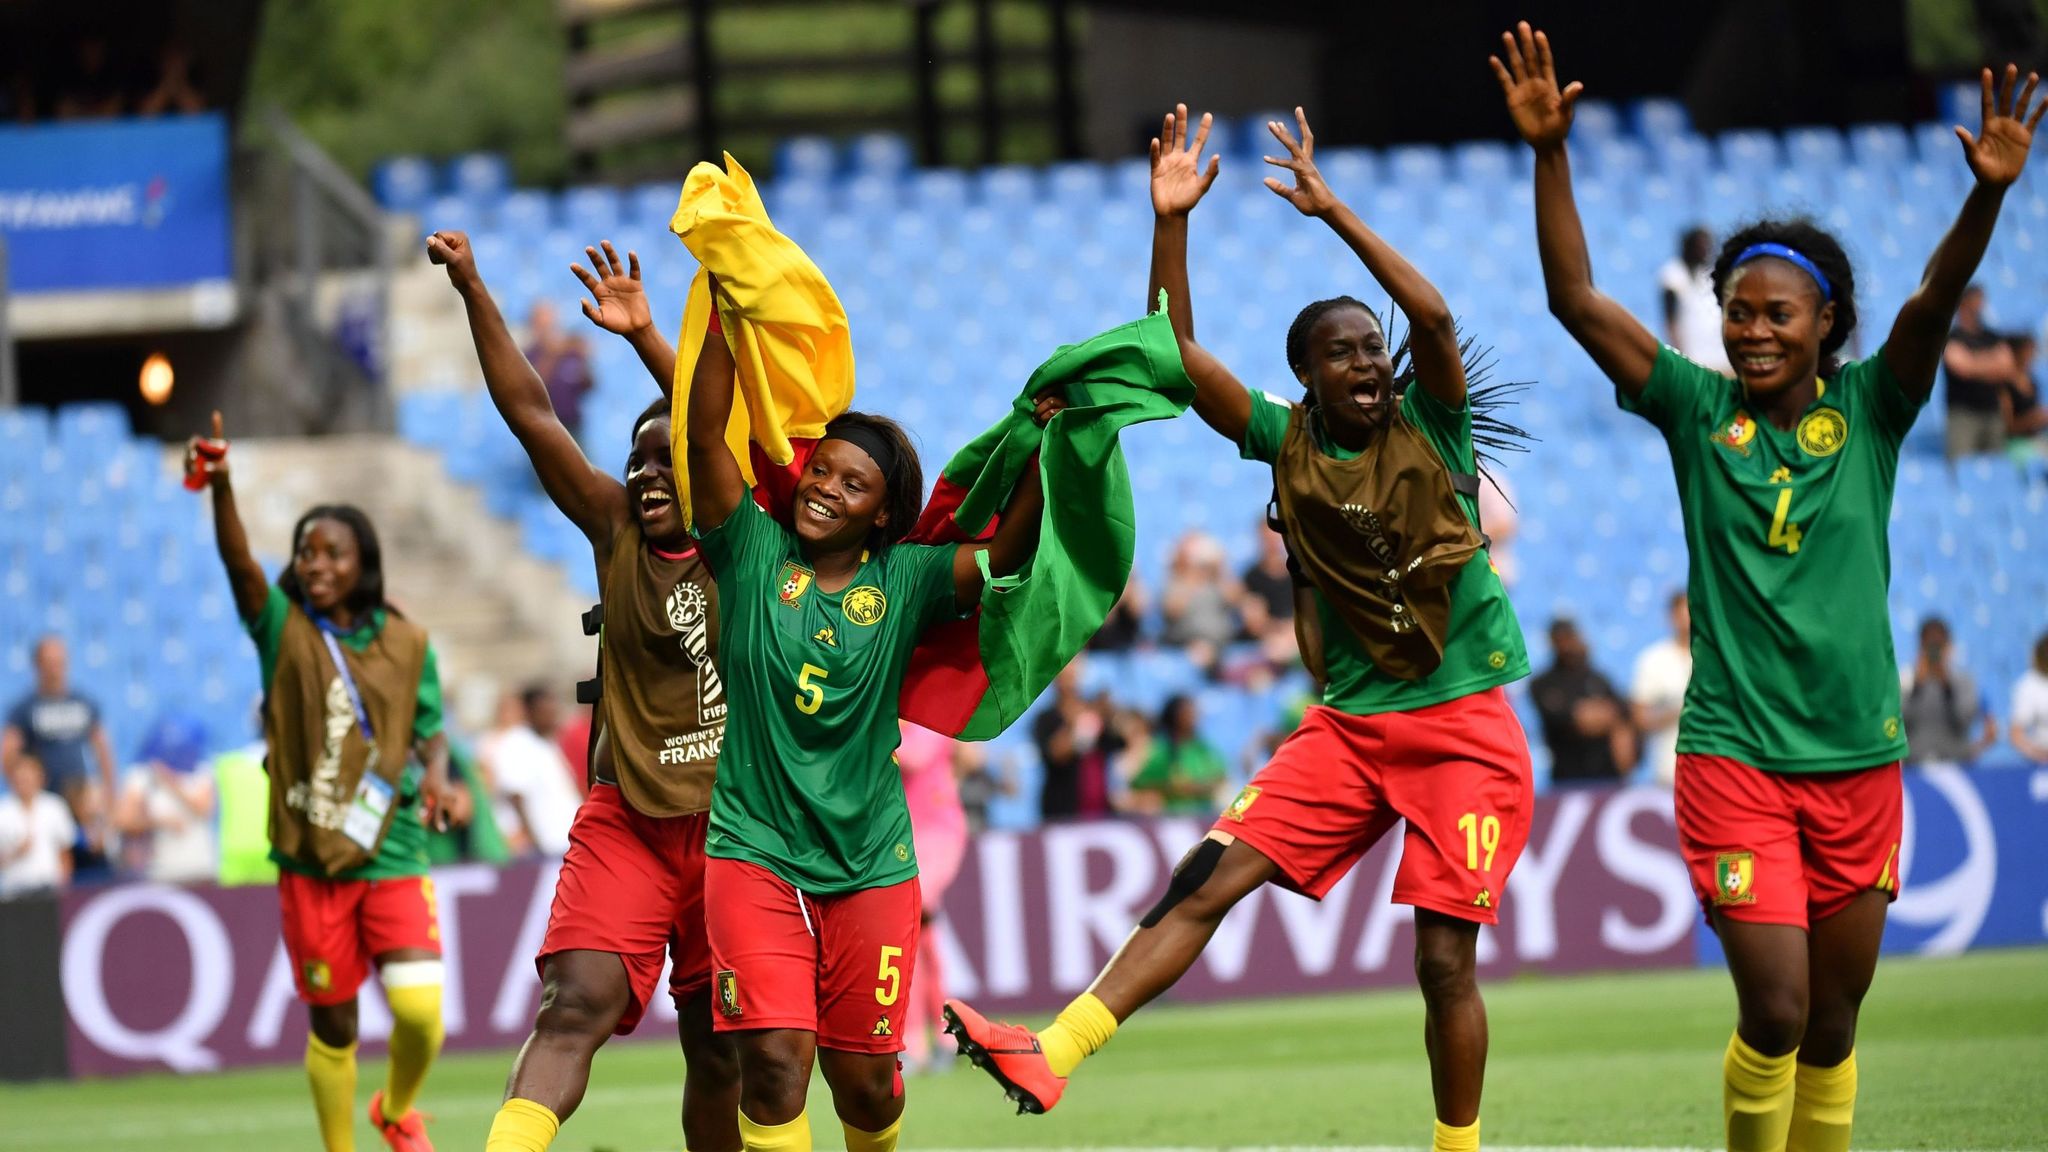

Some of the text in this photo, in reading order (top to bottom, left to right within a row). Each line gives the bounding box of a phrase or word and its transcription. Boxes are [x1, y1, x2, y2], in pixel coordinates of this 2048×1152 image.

[1768, 487, 1802, 554] 4
[702, 703, 728, 721] FIFA
[795, 662, 829, 715] 5
[658, 735, 724, 765] FRANC
[664, 728, 715, 748] WOMEN'S
[1458, 812, 1501, 872] 19
[875, 945, 903, 1006] 5
